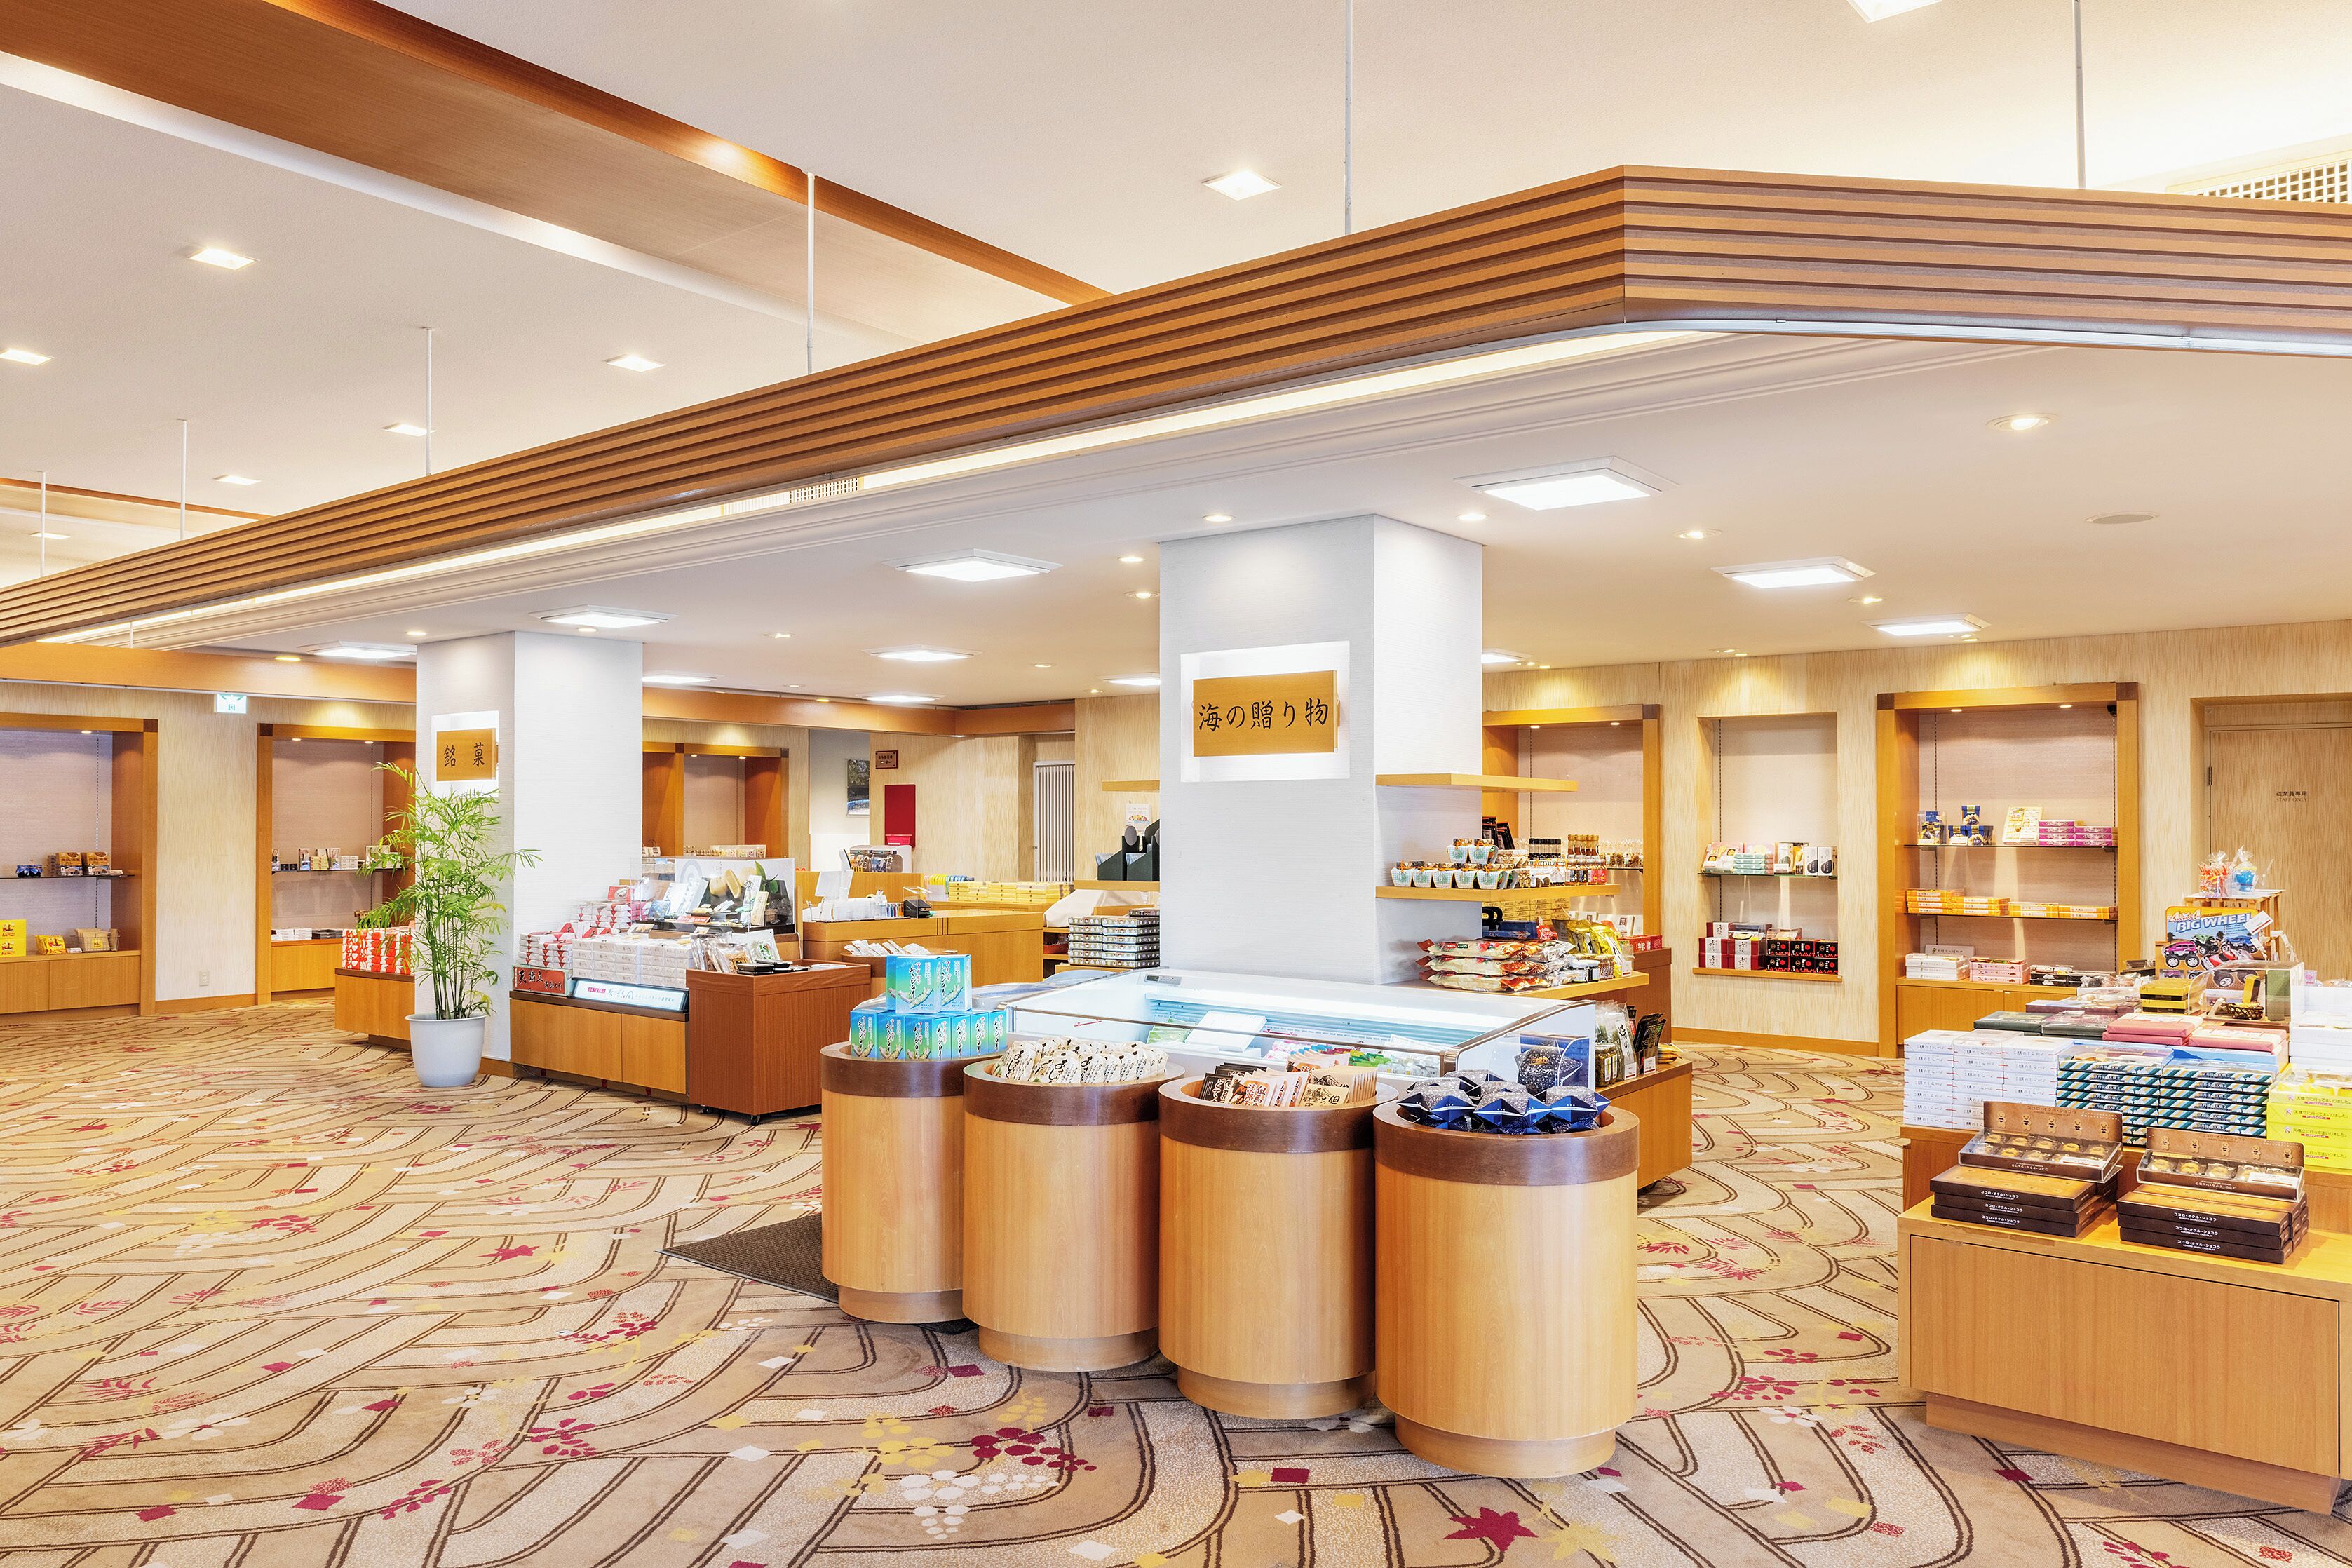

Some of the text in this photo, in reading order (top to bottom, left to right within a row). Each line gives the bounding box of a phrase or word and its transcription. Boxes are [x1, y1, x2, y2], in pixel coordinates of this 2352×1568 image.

[1198, 697, 1329, 732] 海の贈り物
[443, 741, 485, 767] 銘菓
[2176, 912, 2252, 933] BIG WHEEL
[1980, 1190, 2019, 1198] ココロ・オクル・ショコラ
[1985, 1203, 2023, 1212] ココロ・オクル・ショコラ
[1982, 1215, 2020, 1224] ココロ・オクル・ショコラ
[2174, 1212, 2217, 1222] ココロ・オクル・ショコラ
[2175, 1226, 2219, 1236] ココロ・オクル・ショコラ
[2177, 1239, 2221, 1250] ココロ・オクル・ショコラ
